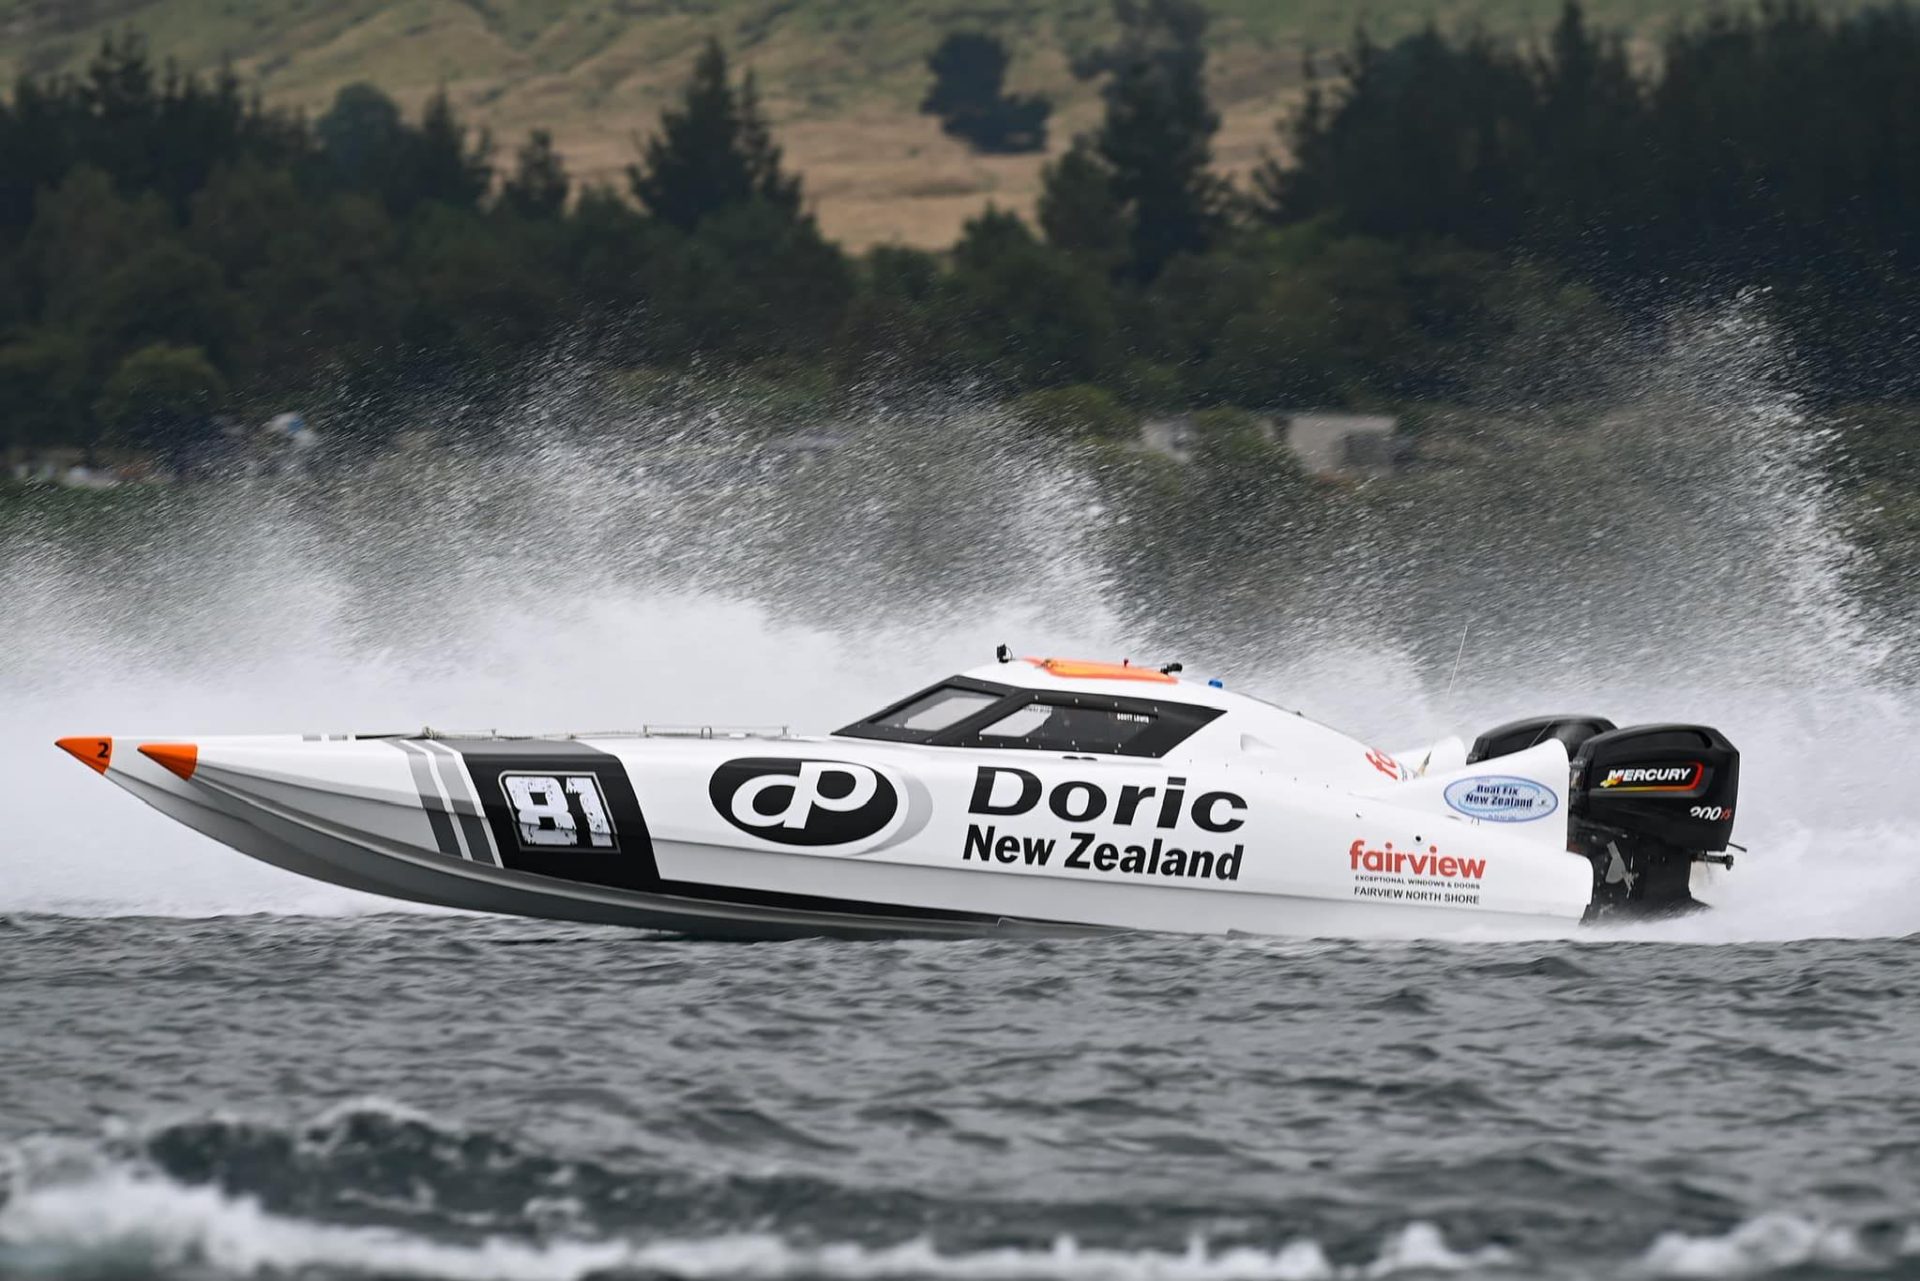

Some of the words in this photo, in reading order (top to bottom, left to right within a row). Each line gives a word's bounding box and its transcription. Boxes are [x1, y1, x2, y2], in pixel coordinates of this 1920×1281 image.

[97, 742, 109, 758] 2
[1606, 768, 1691, 782] MERCURY
[1477, 785, 1500, 794] Boat
[1503, 787, 1519, 795] Fix
[968, 766, 1248, 833] Doric
[1466, 794, 1489, 804] New
[1491, 796, 1533, 808] Zealand
[506, 777, 613, 848] 81
[963, 824, 1056, 866] New
[1064, 832, 1244, 881] Zealand
[1349, 839, 1486, 879] fairview
[1355, 875, 1405, 885] EXCEPTIONAL
[1408, 878, 1445, 888] WINDOWS
[1454, 882, 1480, 890] DOORS
[1354, 886, 1403, 899] FAIRVIEW
[1406, 889, 1441, 901] NORTH
[1444, 893, 1480, 905] SHORE
